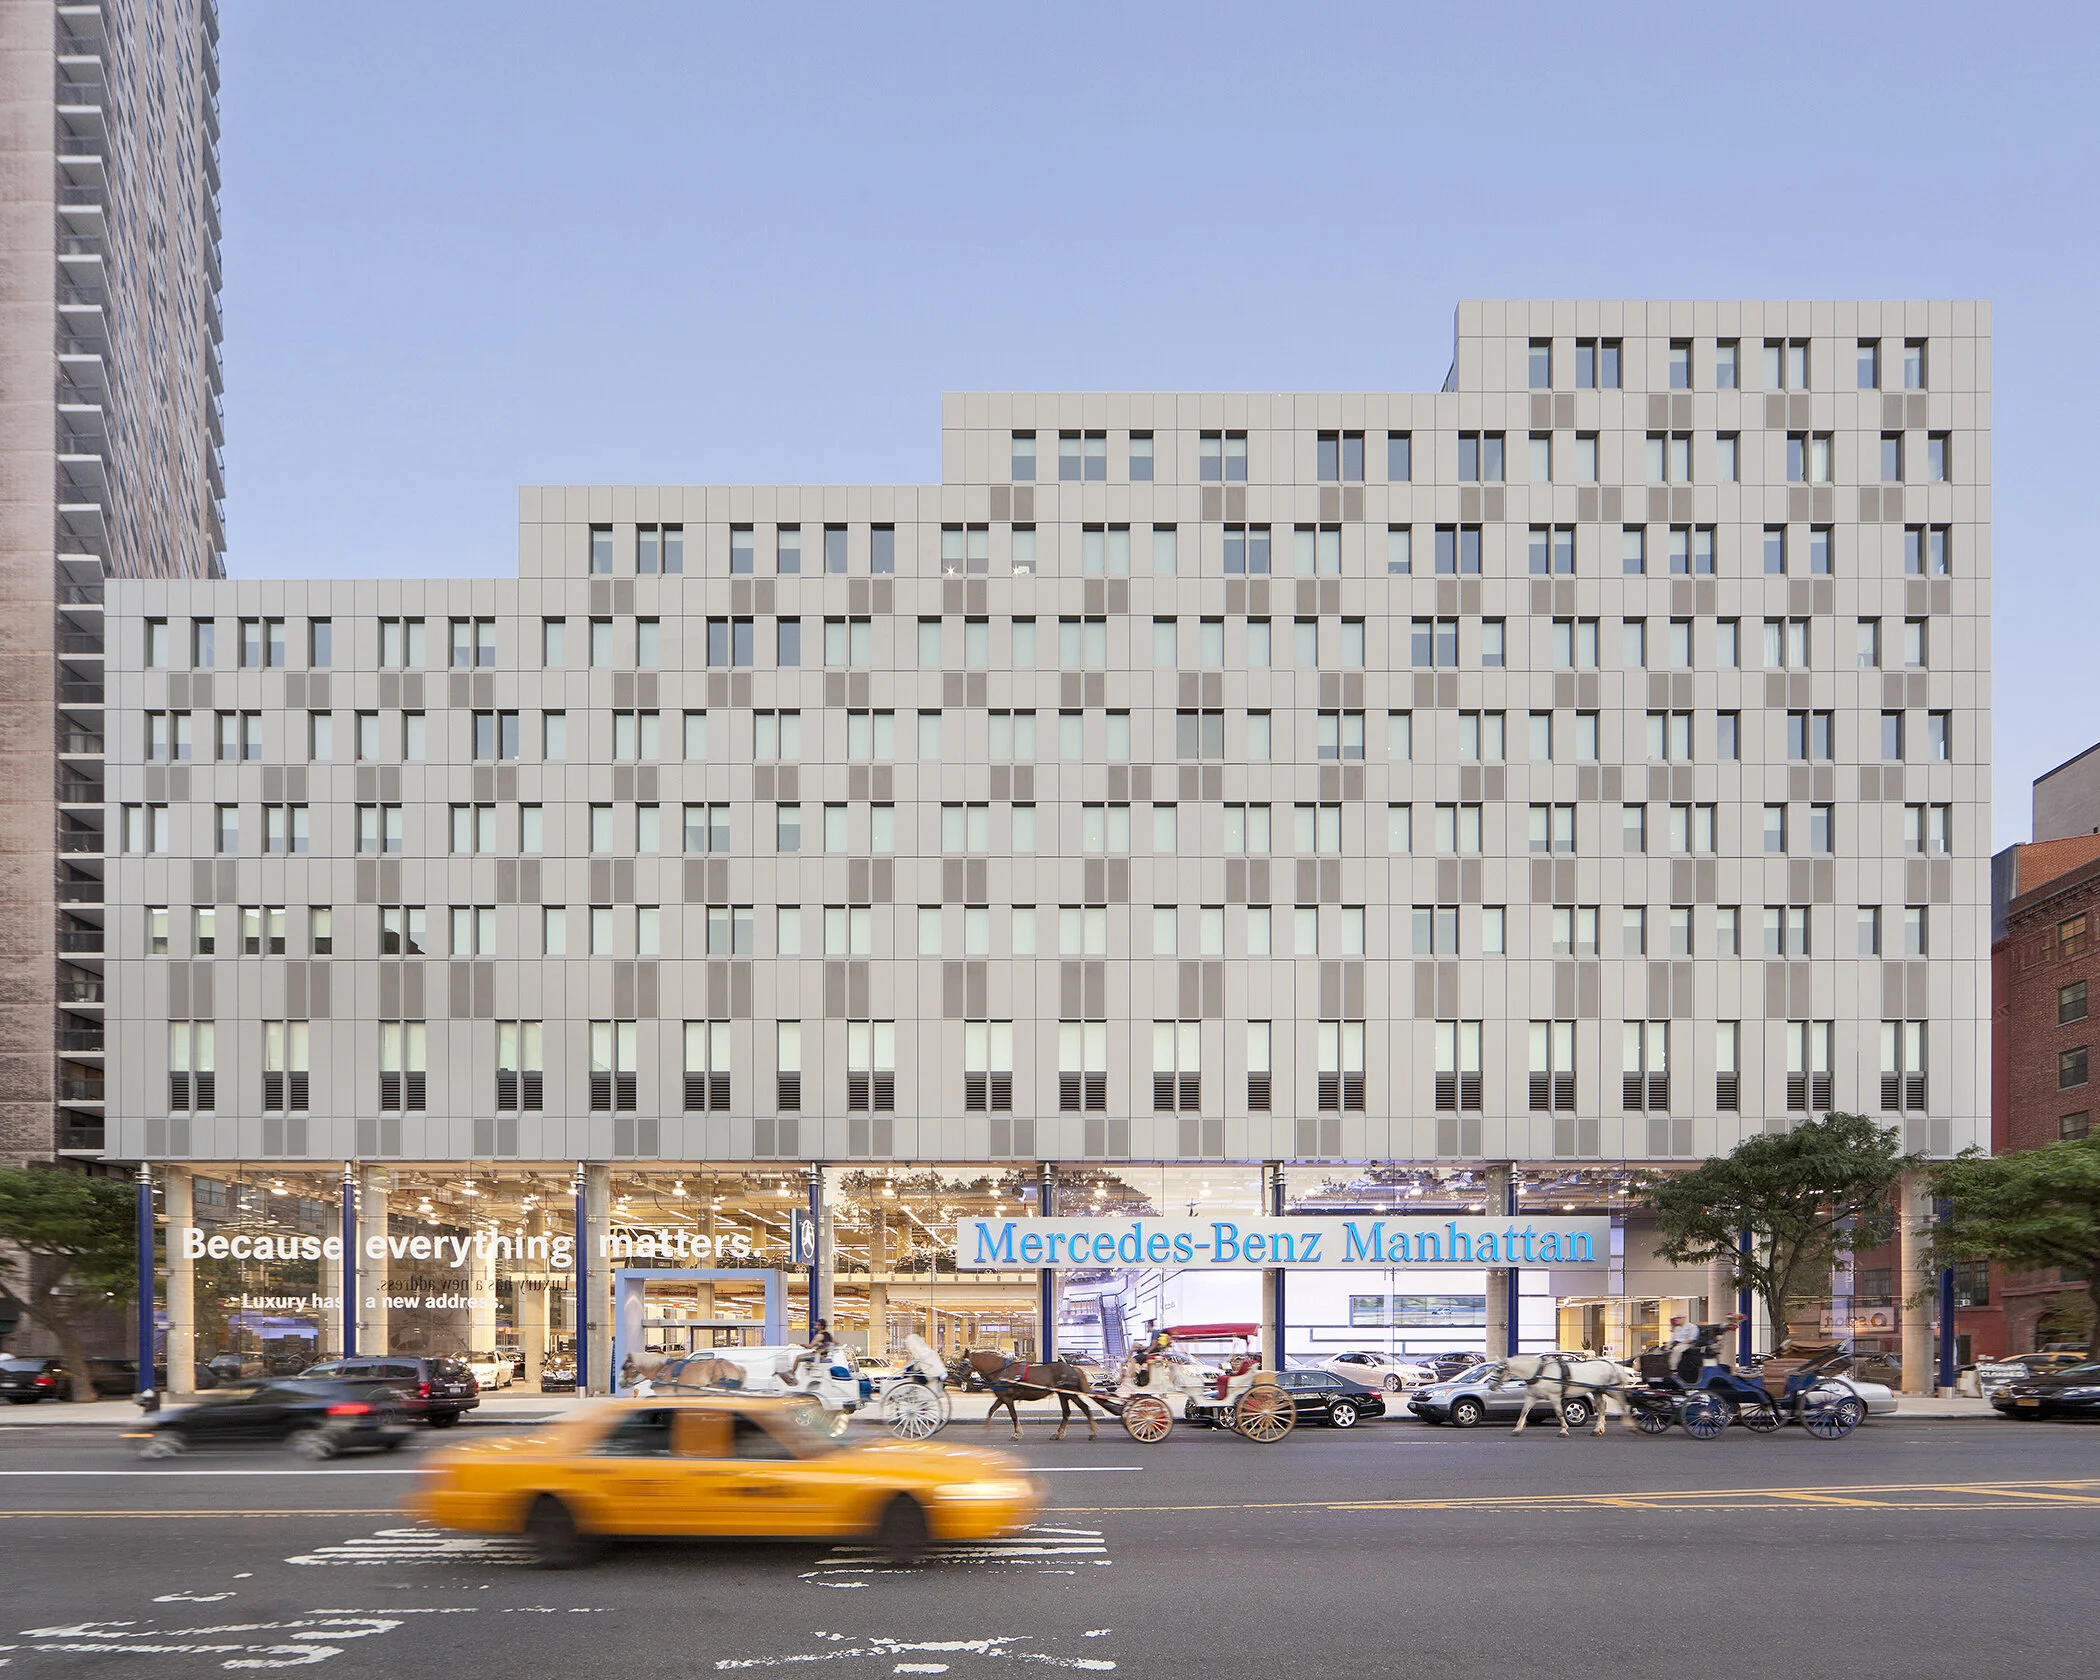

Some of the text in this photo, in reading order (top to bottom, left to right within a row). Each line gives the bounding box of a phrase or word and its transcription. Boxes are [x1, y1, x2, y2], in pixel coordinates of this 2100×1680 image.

[183, 1228, 344, 1260] Because
[366, 1227, 574, 1268] everything
[600, 1229, 762, 1259] matters.
[974, 1221, 1596, 1263] Mercedes-Benz Manhattan
[242, 1293, 504, 1312] Luxury has a new address.
